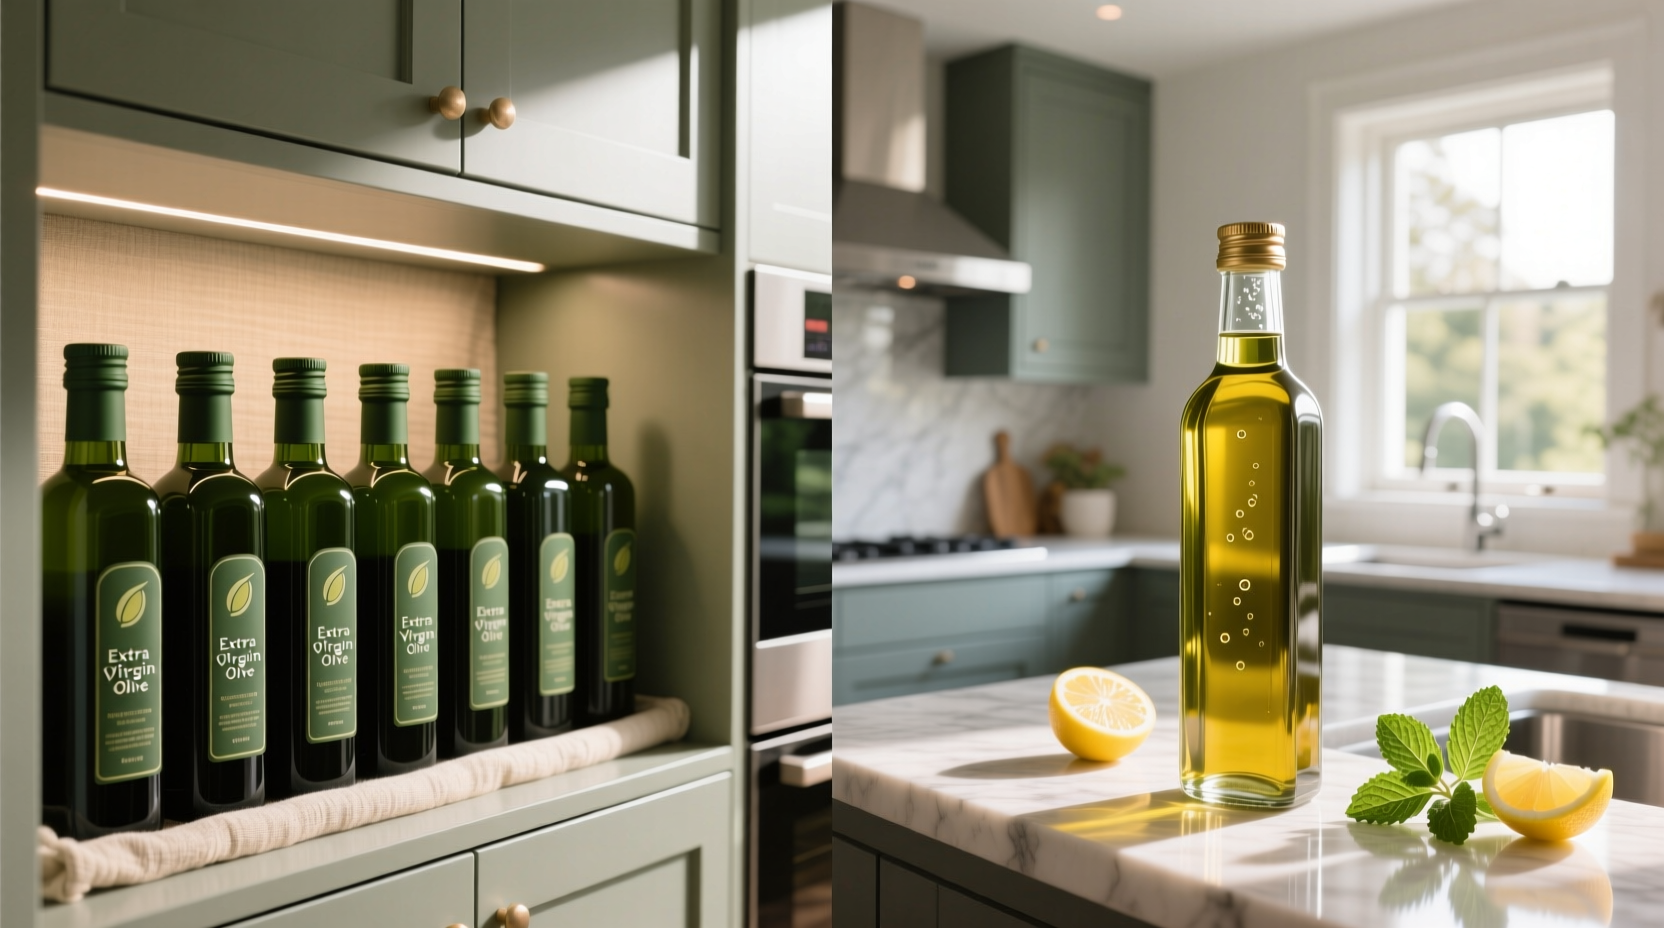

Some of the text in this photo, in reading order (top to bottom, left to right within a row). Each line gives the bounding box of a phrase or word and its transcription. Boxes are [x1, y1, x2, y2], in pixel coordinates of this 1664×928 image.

[317, 626, 350, 639] Extra
[219, 637, 256, 651] Extra
[108, 648, 150, 664] Extra
[103, 662, 156, 681] Virgin
